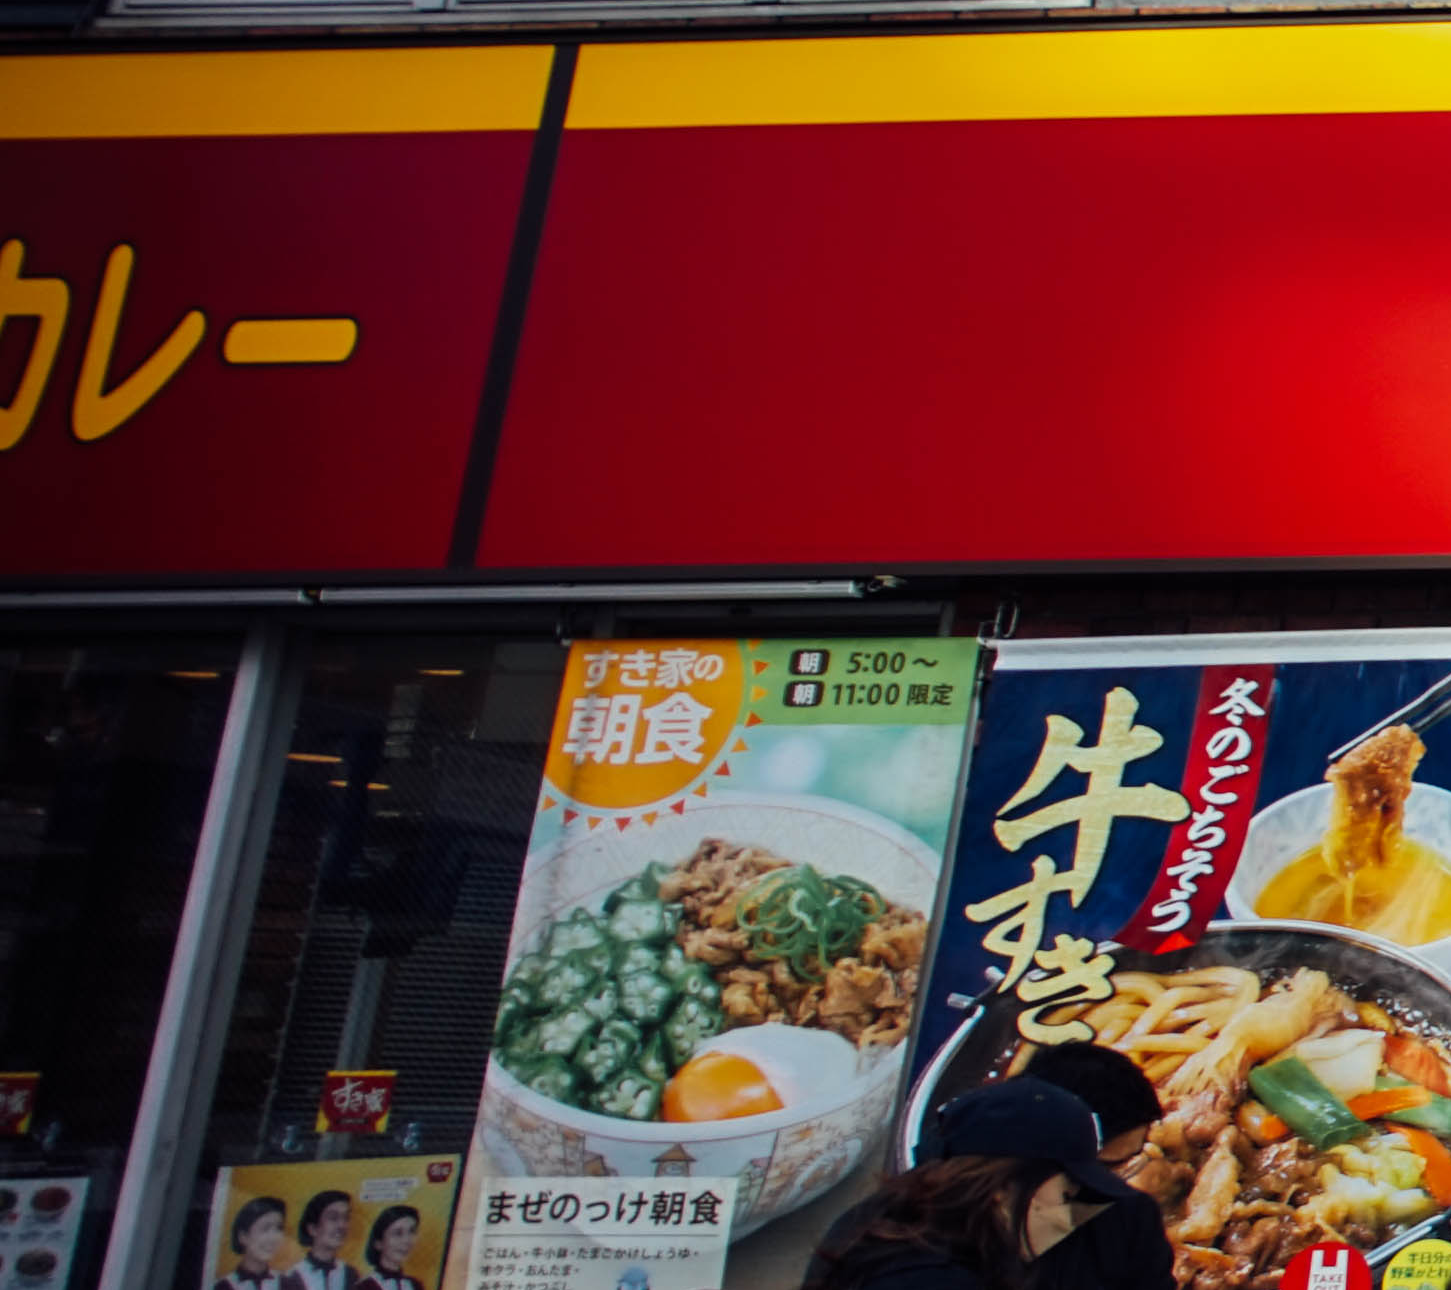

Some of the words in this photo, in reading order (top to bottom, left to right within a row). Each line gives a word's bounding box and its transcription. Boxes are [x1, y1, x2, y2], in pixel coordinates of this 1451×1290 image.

[583, 647, 724, 688] すき家の
[832, 684, 901, 706] 11:00
[907, 683, 954, 706] 限定
[562, 692, 714, 765] 朝食
[1149, 677, 1265, 933] 冬のごちそう
[486, 1190, 723, 1225] まぜのっけ朝食
[1313, 1273, 1343, 1283] TAKE
